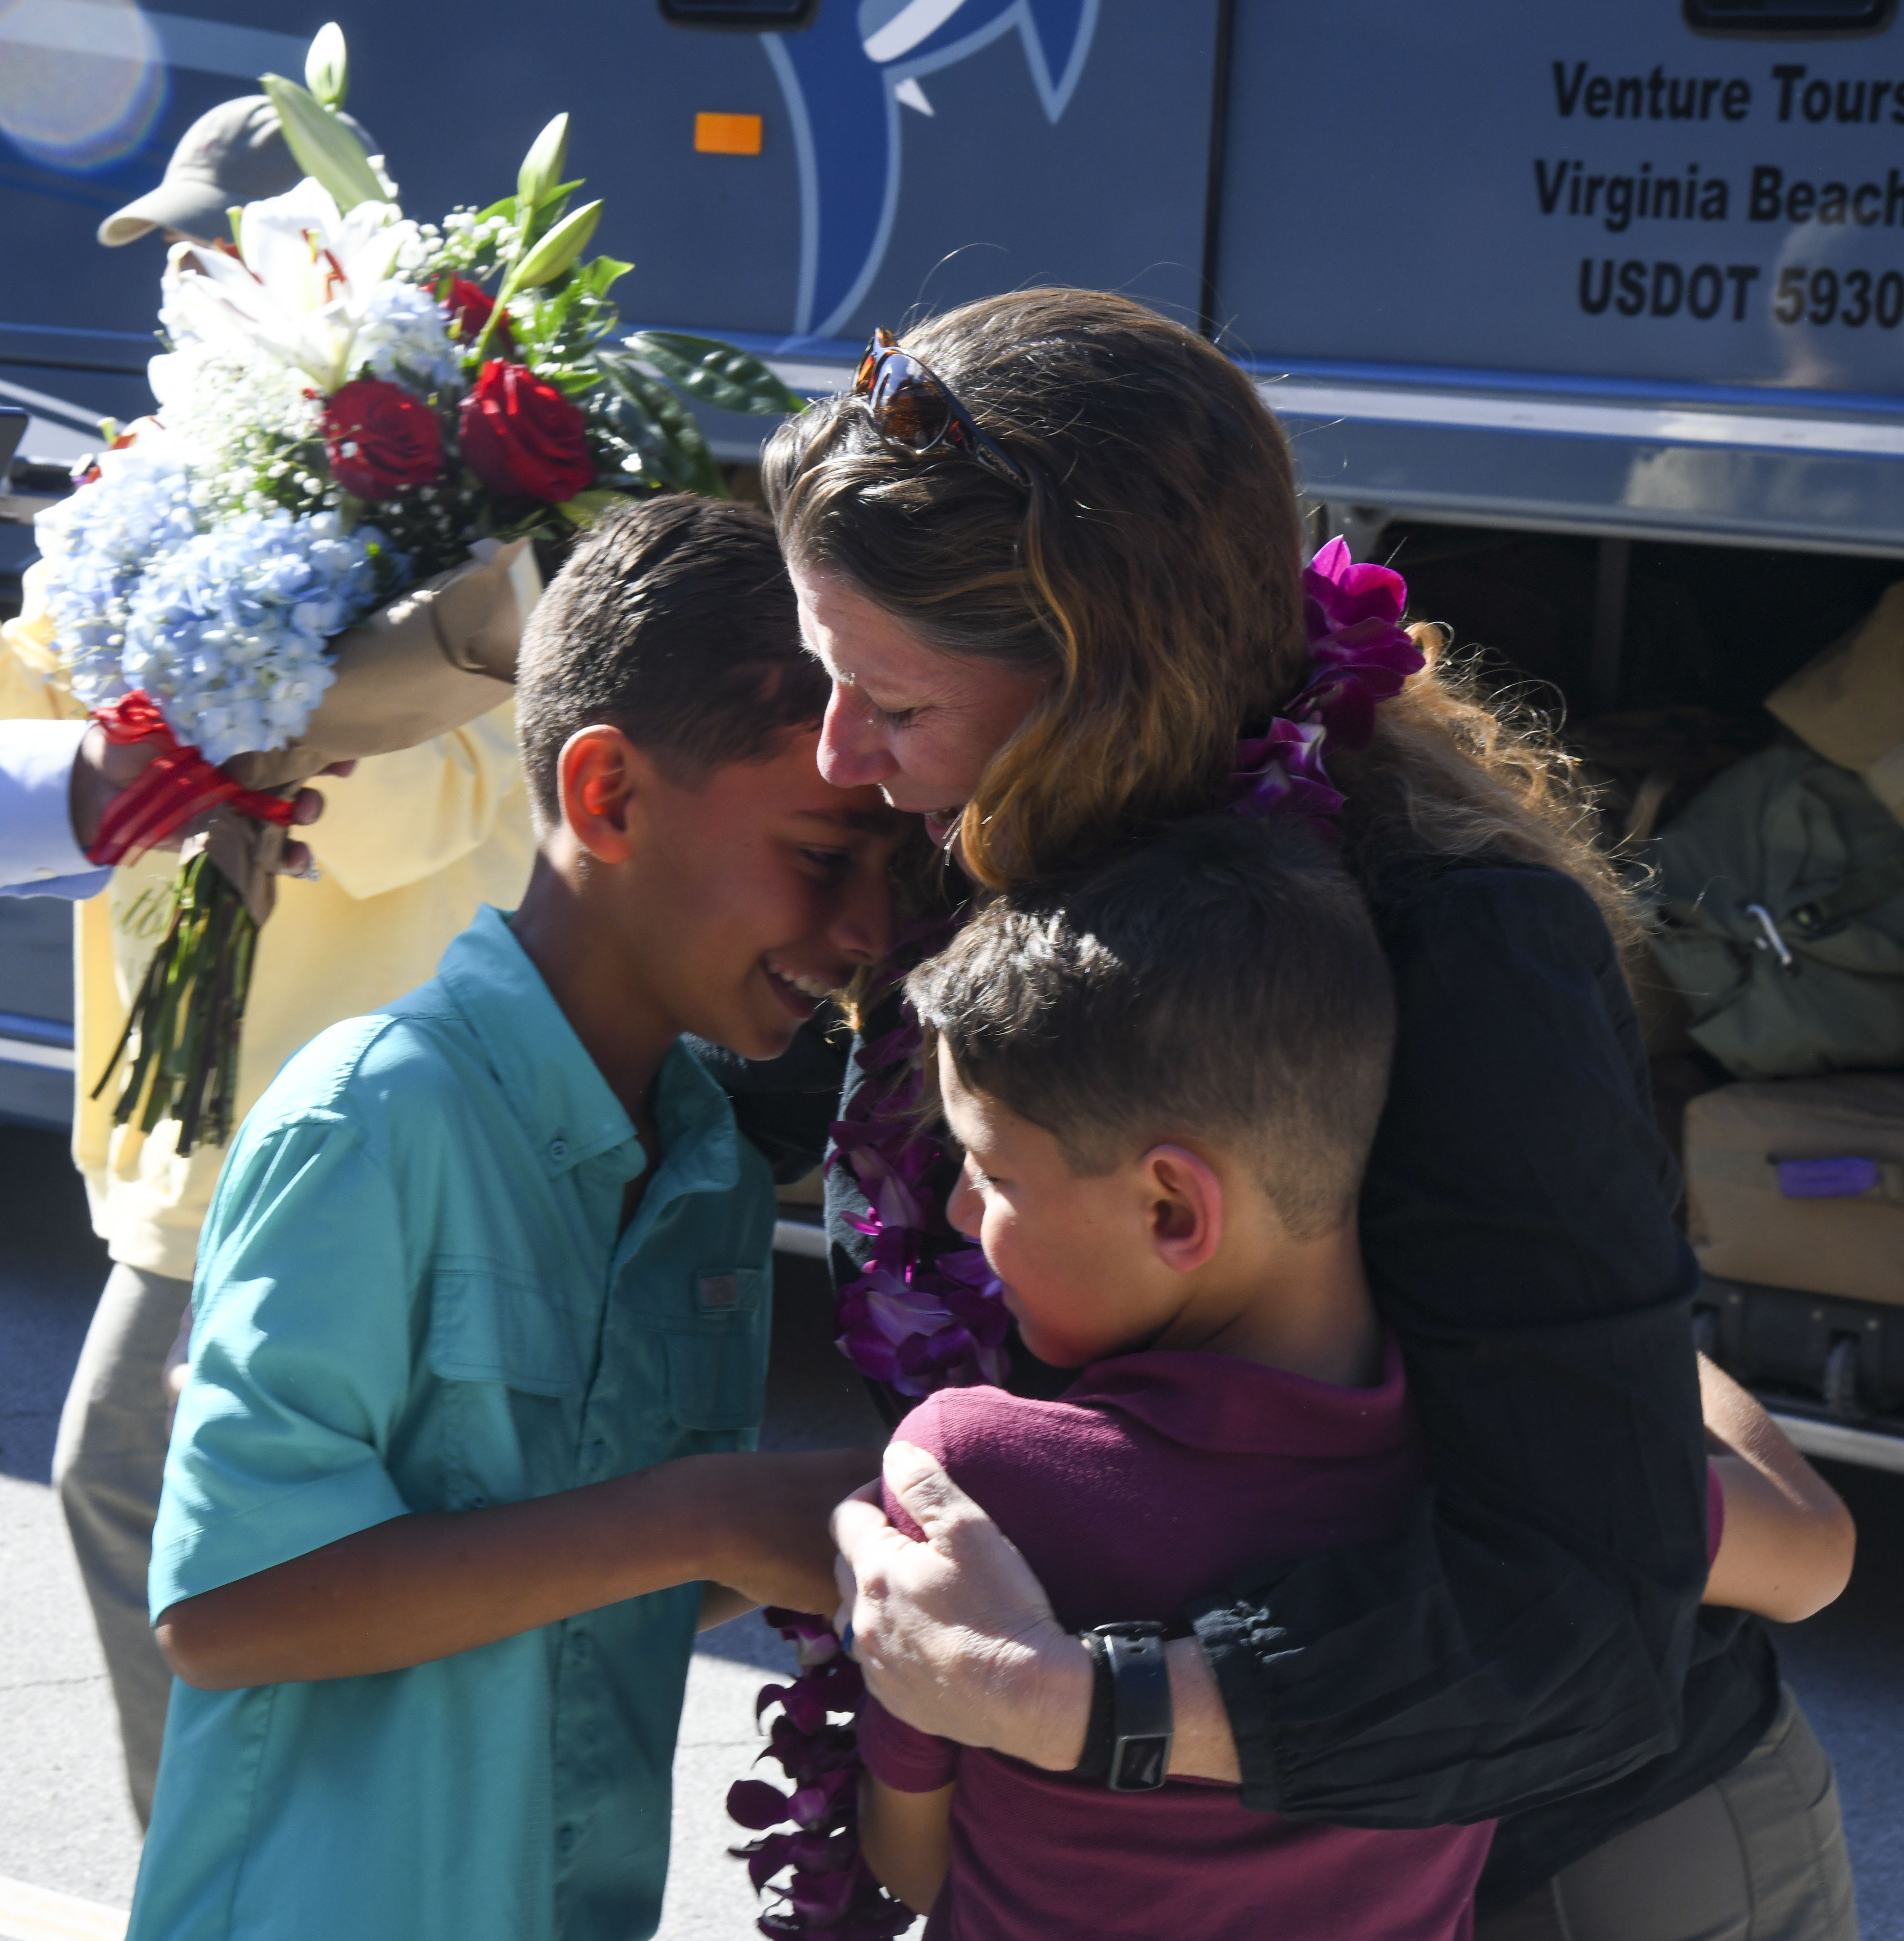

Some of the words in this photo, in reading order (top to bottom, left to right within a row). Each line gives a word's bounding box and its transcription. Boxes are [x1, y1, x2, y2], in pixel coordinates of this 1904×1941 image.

[1552, 61, 1751, 121] Venture
[1534, 159, 1729, 233] Virginia
[1749, 165, 1904, 227] Beach
[1578, 259, 1760, 321] USDOT
[1774, 267, 1904, 329] 5930
